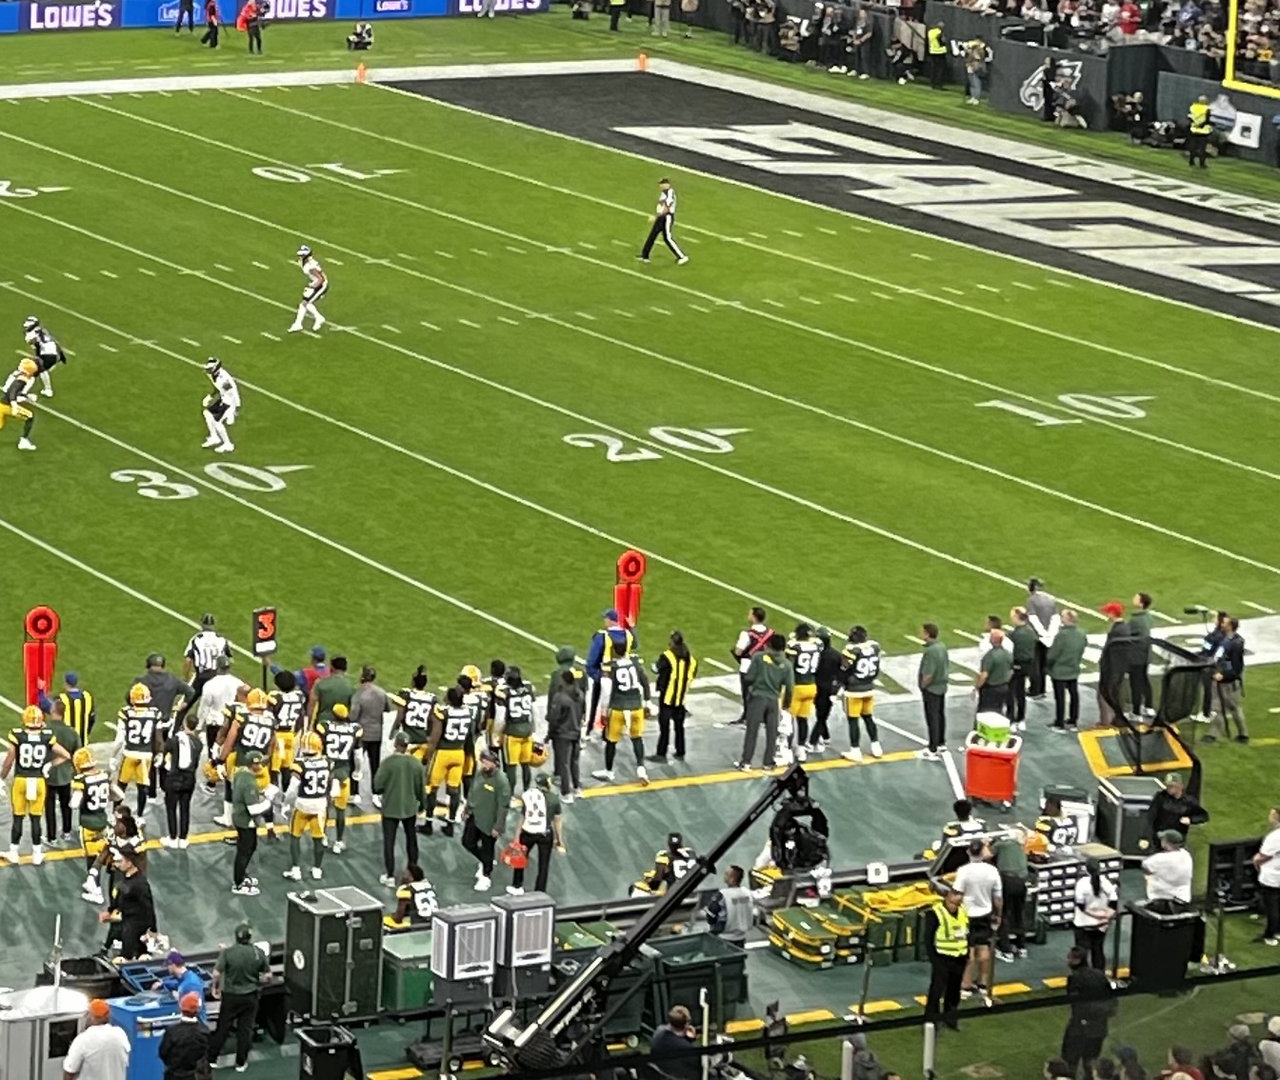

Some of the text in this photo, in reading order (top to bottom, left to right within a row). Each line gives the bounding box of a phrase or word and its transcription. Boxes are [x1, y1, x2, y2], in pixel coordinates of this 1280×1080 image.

[31, 0, 113, 29] LOWE'S
[257, 610, 276, 640] 3
[615, 666, 638, 692] 91
[855, 658, 878, 680] 95
[277, 700, 303, 729] 45
[404, 700, 433, 728] 29
[509, 694, 533, 718] 59
[127, 719, 154, 745] 24
[240, 722, 272, 749] 90
[444, 717, 472, 741] 55
[18, 742, 47, 769] 89
[326, 733, 356, 761] 27
[303, 770, 329, 796] 33
[86, 783, 111, 811] 39
